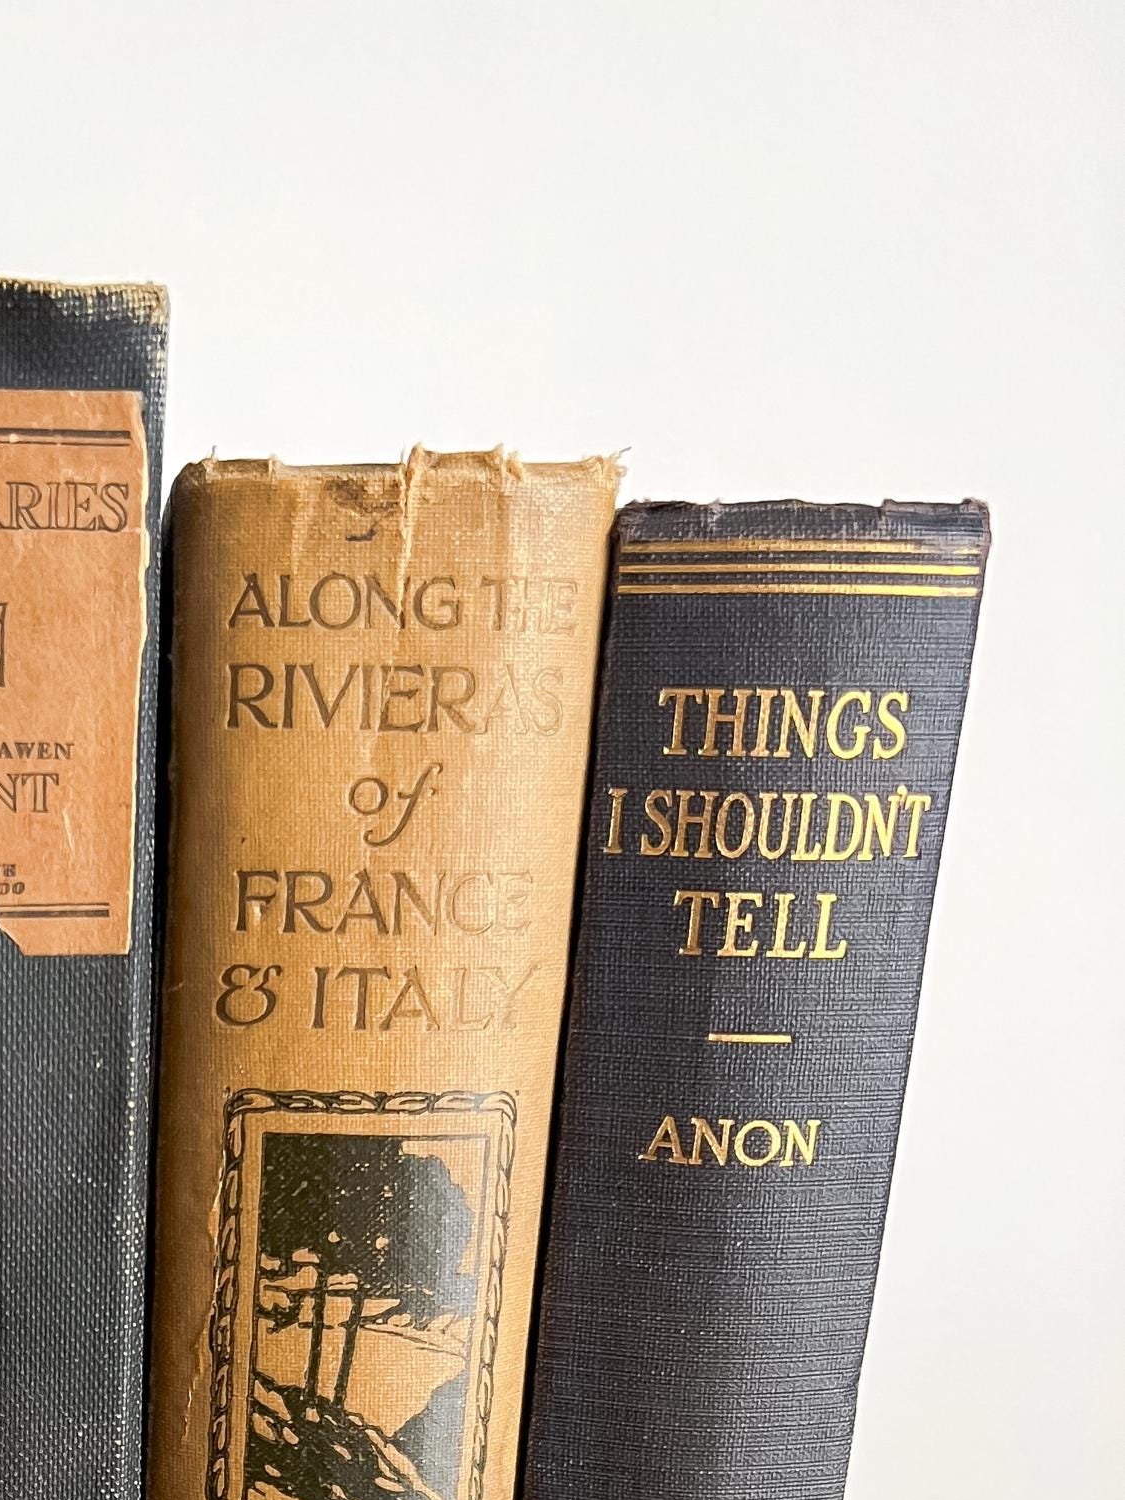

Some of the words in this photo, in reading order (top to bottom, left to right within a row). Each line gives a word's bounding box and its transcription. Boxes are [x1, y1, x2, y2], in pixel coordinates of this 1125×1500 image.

[227, 570, 460, 631] ALONG
[480, 574, 578, 637] THE
[226, 663, 565, 736] RIVIERAS
[659, 687, 910, 760] THINGS
[349, 762, 443, 847] of
[603, 787, 628, 854] I
[640, 784, 932, 861] SHOULDN'T
[235, 868, 533, 936] FRANCE
[674, 889, 848, 960] TELL
[214, 964, 283, 1027] &
[310, 963, 541, 1031] ITALY
[638, 1115, 821, 1168] ANON
